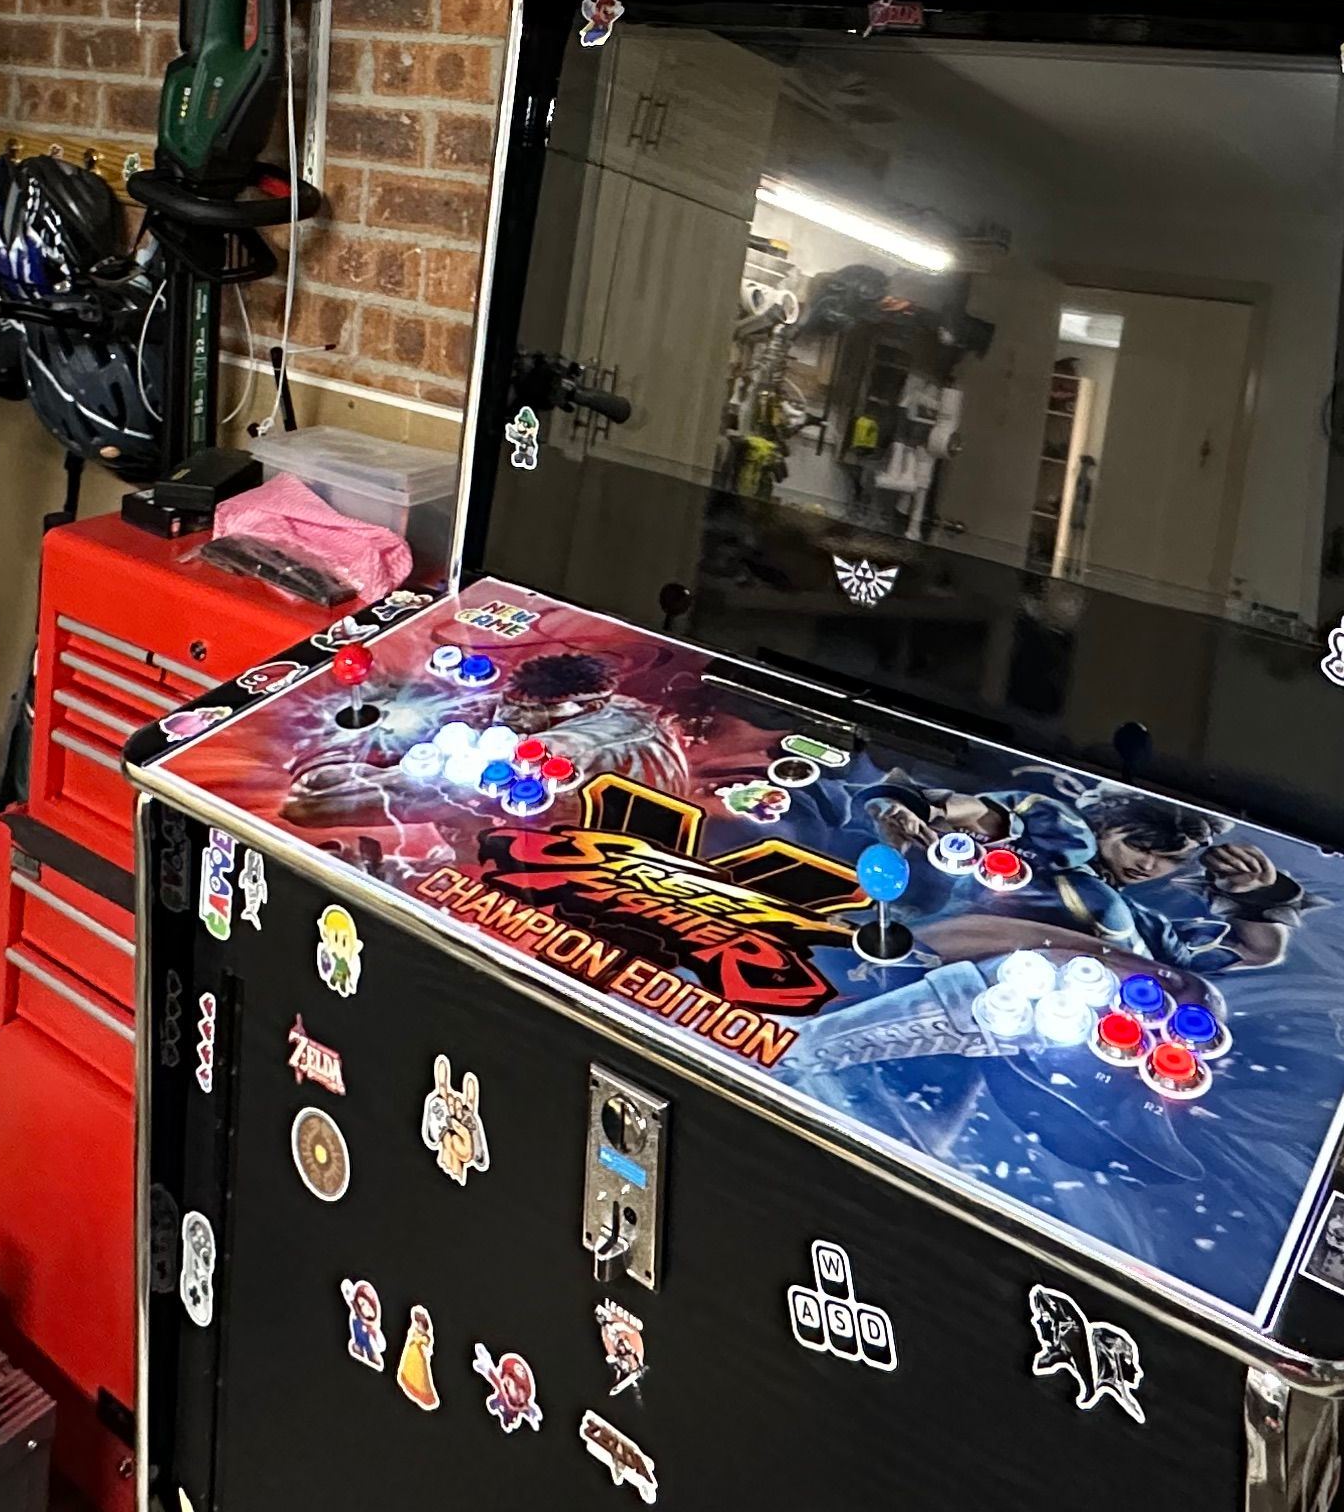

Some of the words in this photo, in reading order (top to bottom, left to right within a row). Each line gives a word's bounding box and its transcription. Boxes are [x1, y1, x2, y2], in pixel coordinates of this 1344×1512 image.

[457, 609, 526, 637] GAME
[481, 601, 537, 623] NEW
[496, 828, 858, 937] STREET
[491, 868, 829, 1008] FIGHTER
[417, 867, 621, 979] CHAMPION
[609, 958, 800, 1068] EDITION
[821, 1254, 840, 1277] W
[802, 1300, 815, 1323] A
[834, 1309, 846, 1331] S
[867, 1318, 881, 1340] D
